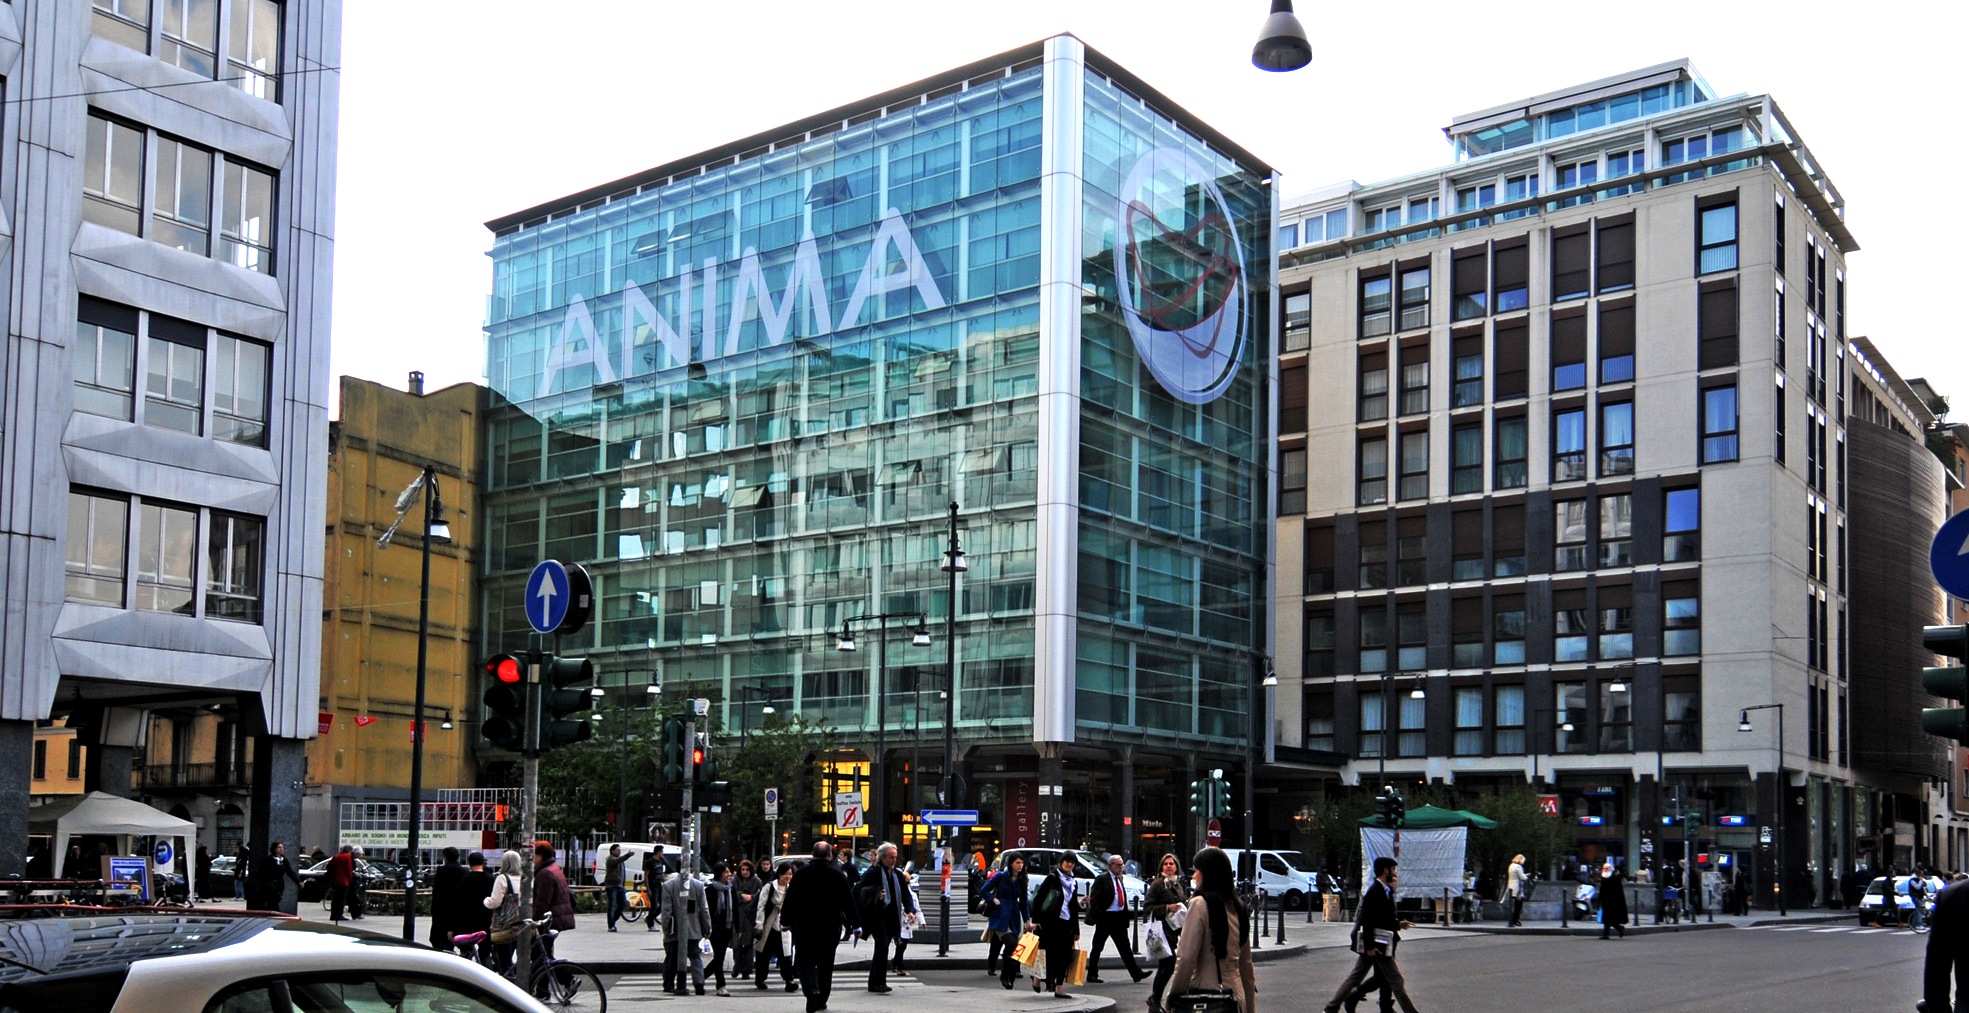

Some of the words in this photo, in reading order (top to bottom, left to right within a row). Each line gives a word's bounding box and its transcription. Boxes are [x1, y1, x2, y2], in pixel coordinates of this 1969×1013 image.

[536, 206, 946, 398] ANIMA
[1017, 782, 1028, 832] gallery
[1142, 819, 1163, 828] Miele
